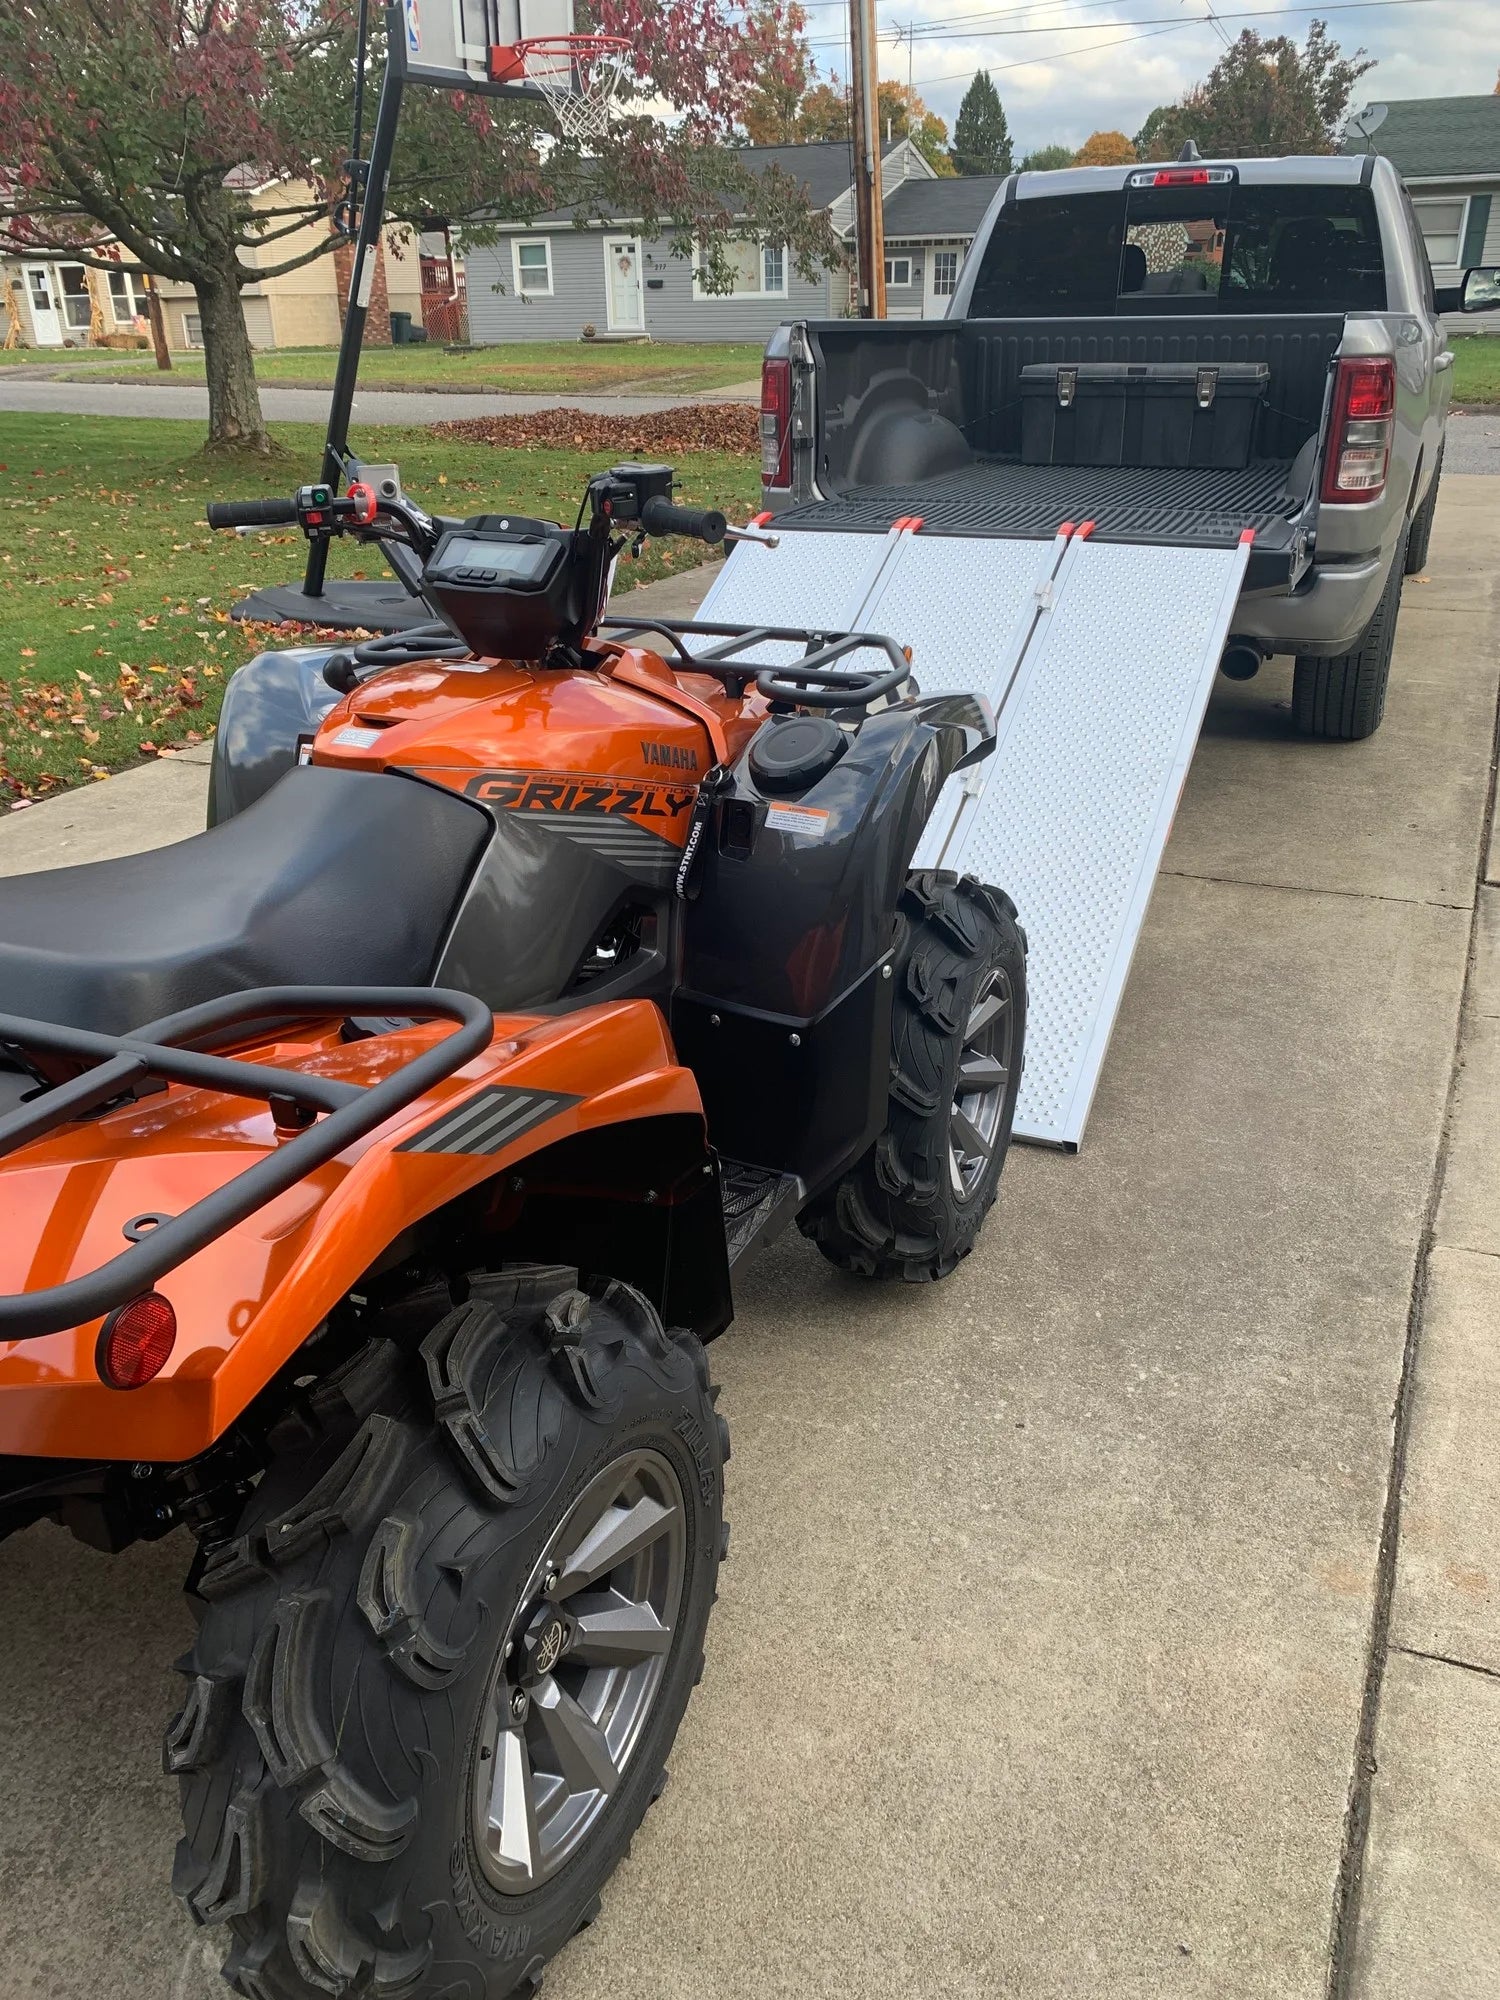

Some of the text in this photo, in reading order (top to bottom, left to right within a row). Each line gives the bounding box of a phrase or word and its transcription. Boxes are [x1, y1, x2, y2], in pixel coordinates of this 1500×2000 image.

[642, 742, 697, 771] YAMAHA
[464, 773, 695, 817] GRIZZLY
[532, 775, 696, 796] SPECIAL EDITION
[673, 1405, 716, 1498] ZILLA
[449, 1837, 532, 1961] MAXXIS
